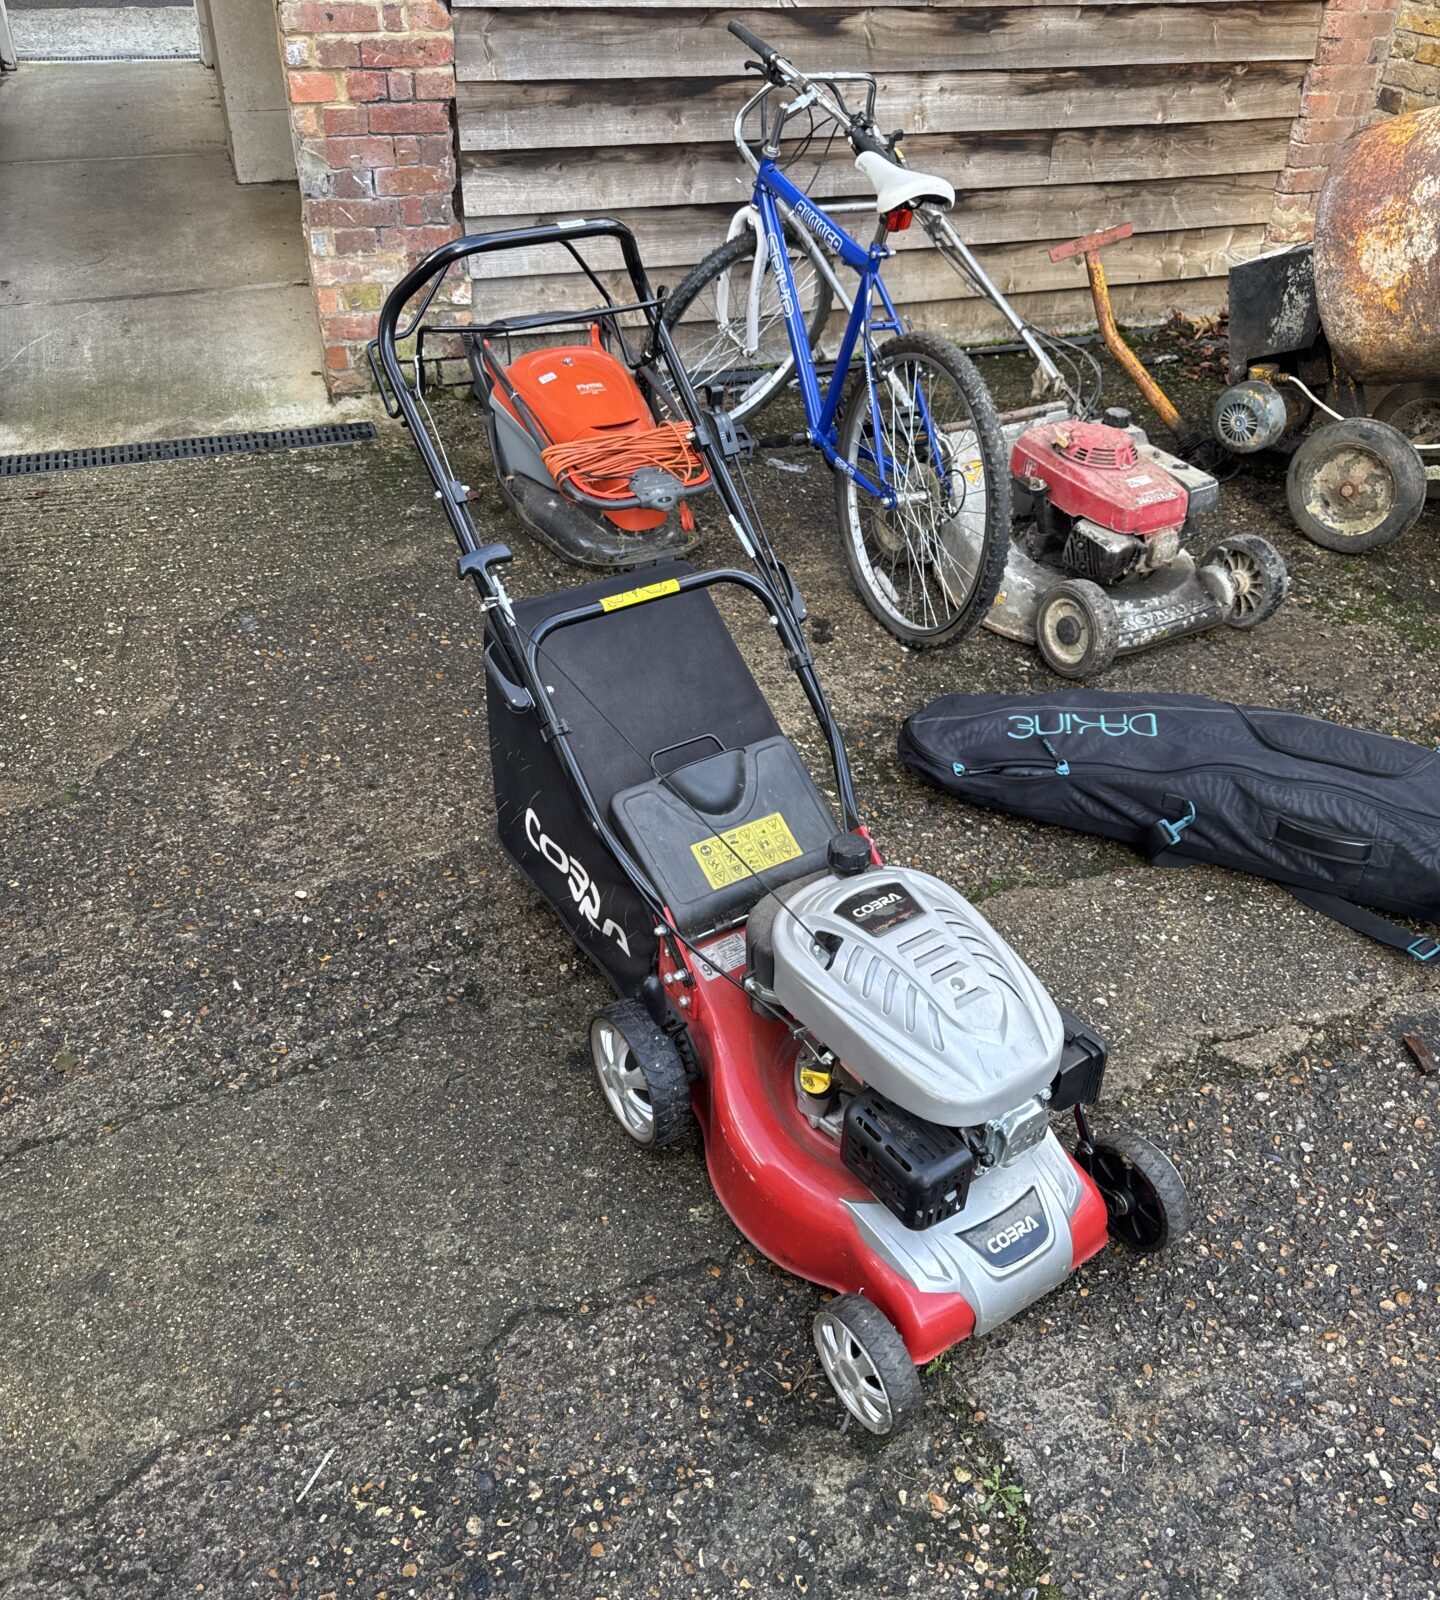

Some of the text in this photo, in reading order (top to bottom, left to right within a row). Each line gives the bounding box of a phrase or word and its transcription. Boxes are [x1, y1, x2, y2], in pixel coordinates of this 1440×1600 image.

[525, 807, 631, 958] COBRA
[852, 892, 903, 918] COBRA
[987, 1215, 1040, 1254] COBRA
